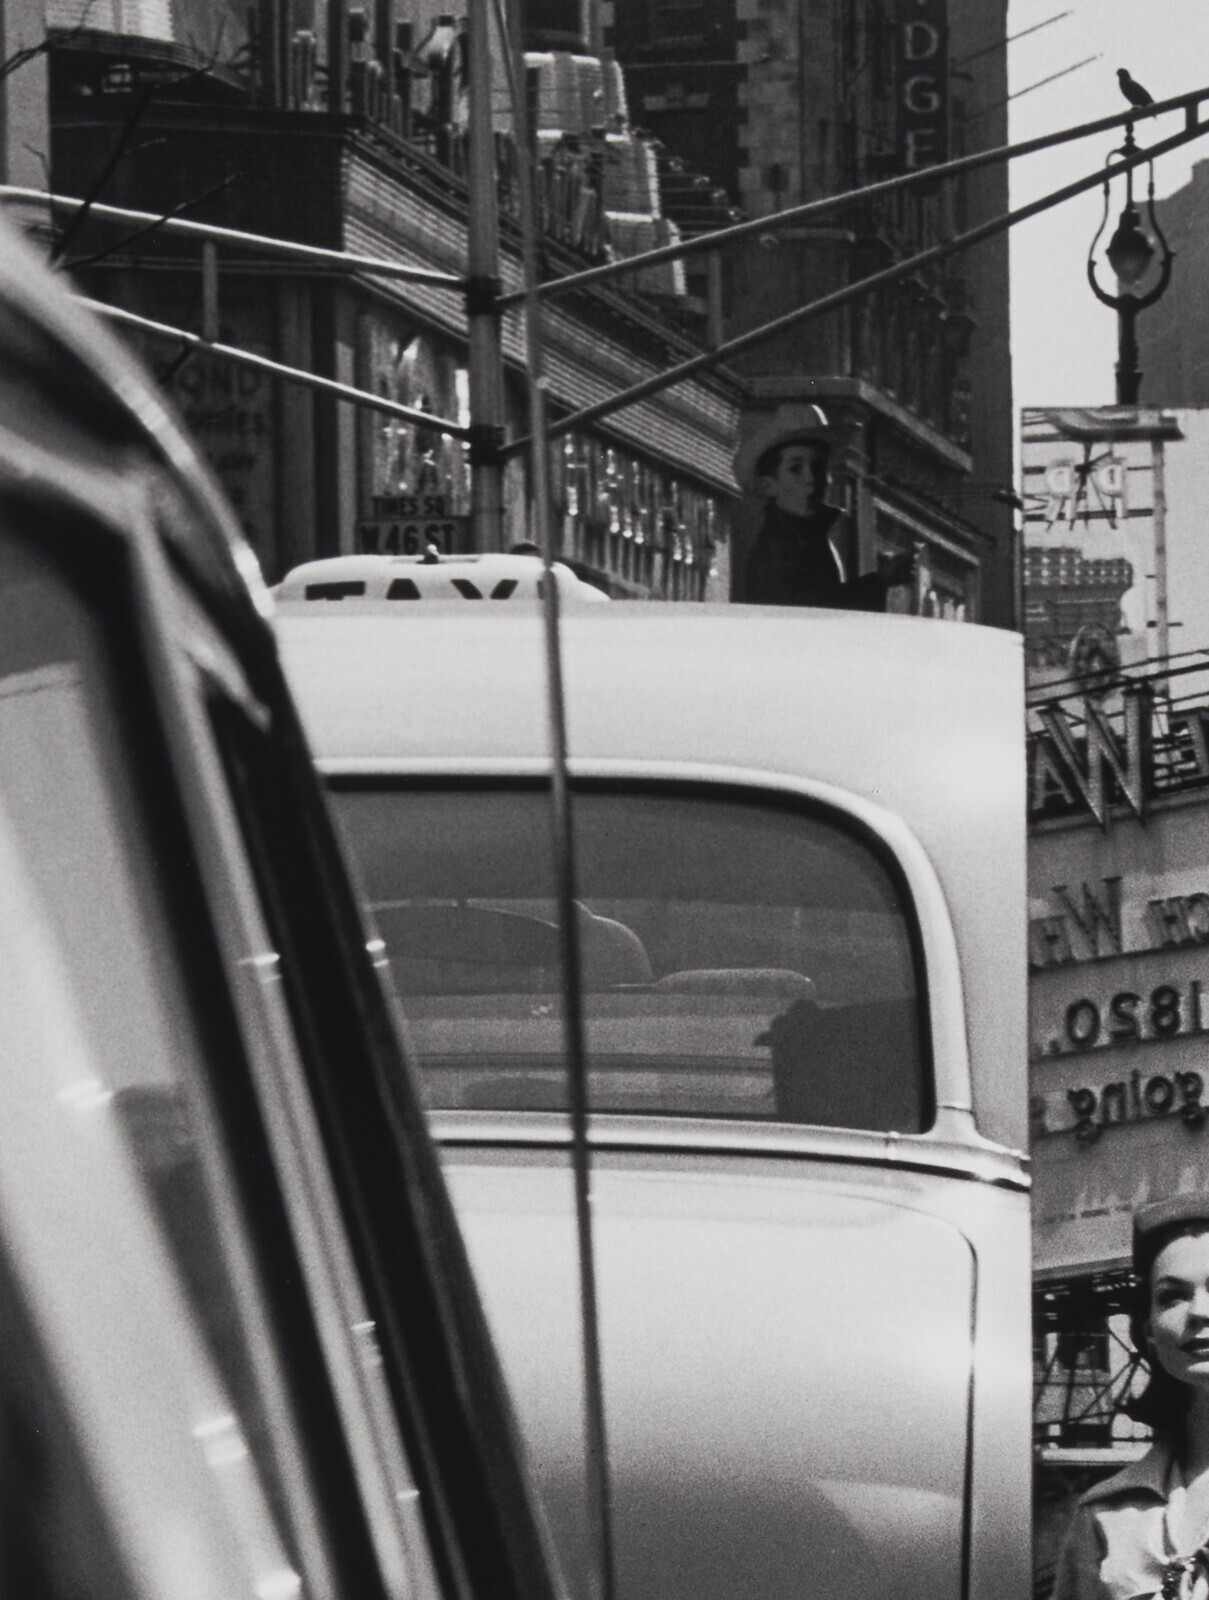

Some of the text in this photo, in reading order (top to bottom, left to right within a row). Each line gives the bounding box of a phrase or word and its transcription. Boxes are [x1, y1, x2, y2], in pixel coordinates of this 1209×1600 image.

[371, 495, 446, 516] TIMES SQ
[385, 523, 418, 554] 46
[424, 523, 455, 554] ST
